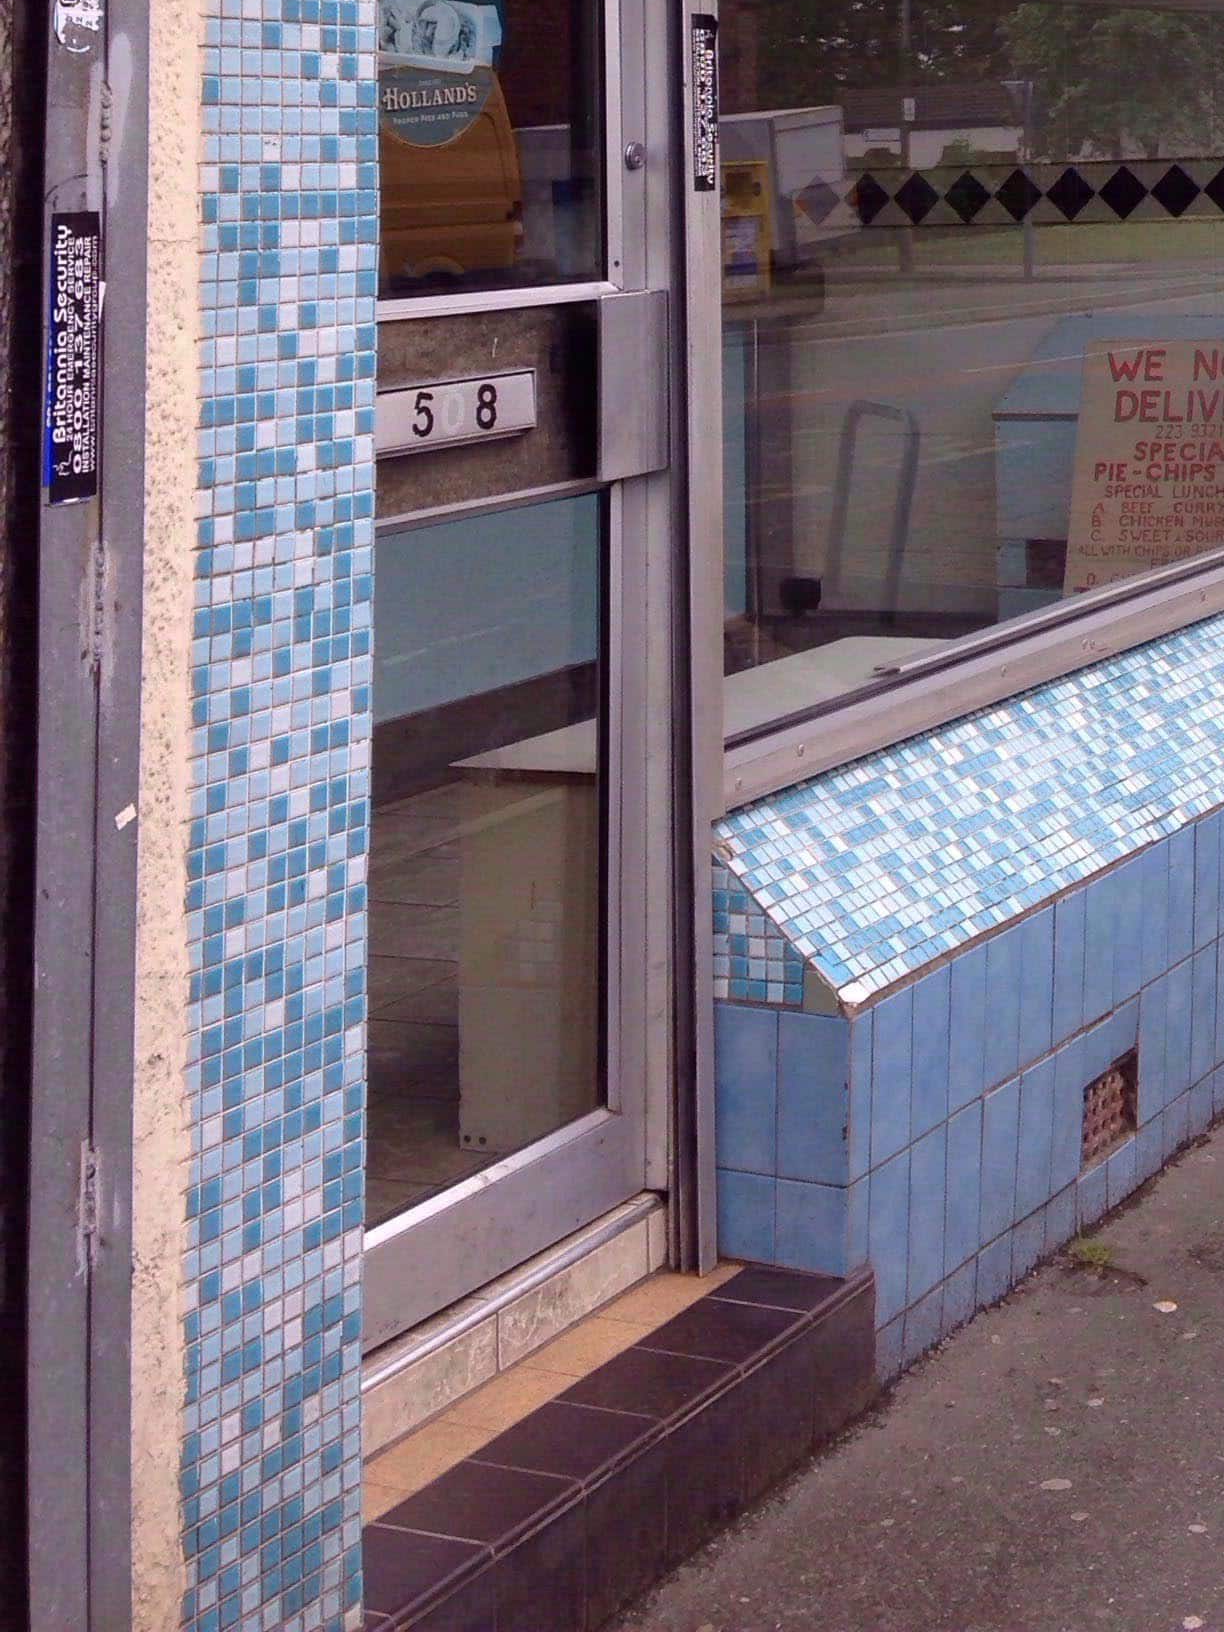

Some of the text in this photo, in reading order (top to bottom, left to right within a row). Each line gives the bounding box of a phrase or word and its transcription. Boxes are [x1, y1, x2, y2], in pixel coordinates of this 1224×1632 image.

[382, 81, 477, 110] HOLLAND'S
[52, 225, 72, 443] Britannia Security
[83, 286, 91, 379] MAINTENANCE
[73, 237, 84, 474] 0800 137 683
[1107, 349, 1166, 382] WE
[66, 385, 74, 423] HOUR
[412, 383, 497, 438] 508
[82, 383, 90, 473] INSTALLATION
[1155, 423, 1223, 440] 223 9321
[1092, 501, 1104, 514] A
[1121, 502, 1153, 514] BEEF
[1104, 485, 1163, 499] SPECIAL
[1091, 515, 1102, 528] B
[1119, 514, 1184, 528] CHICKEN
[1118, 529, 1171, 542] SWEET
